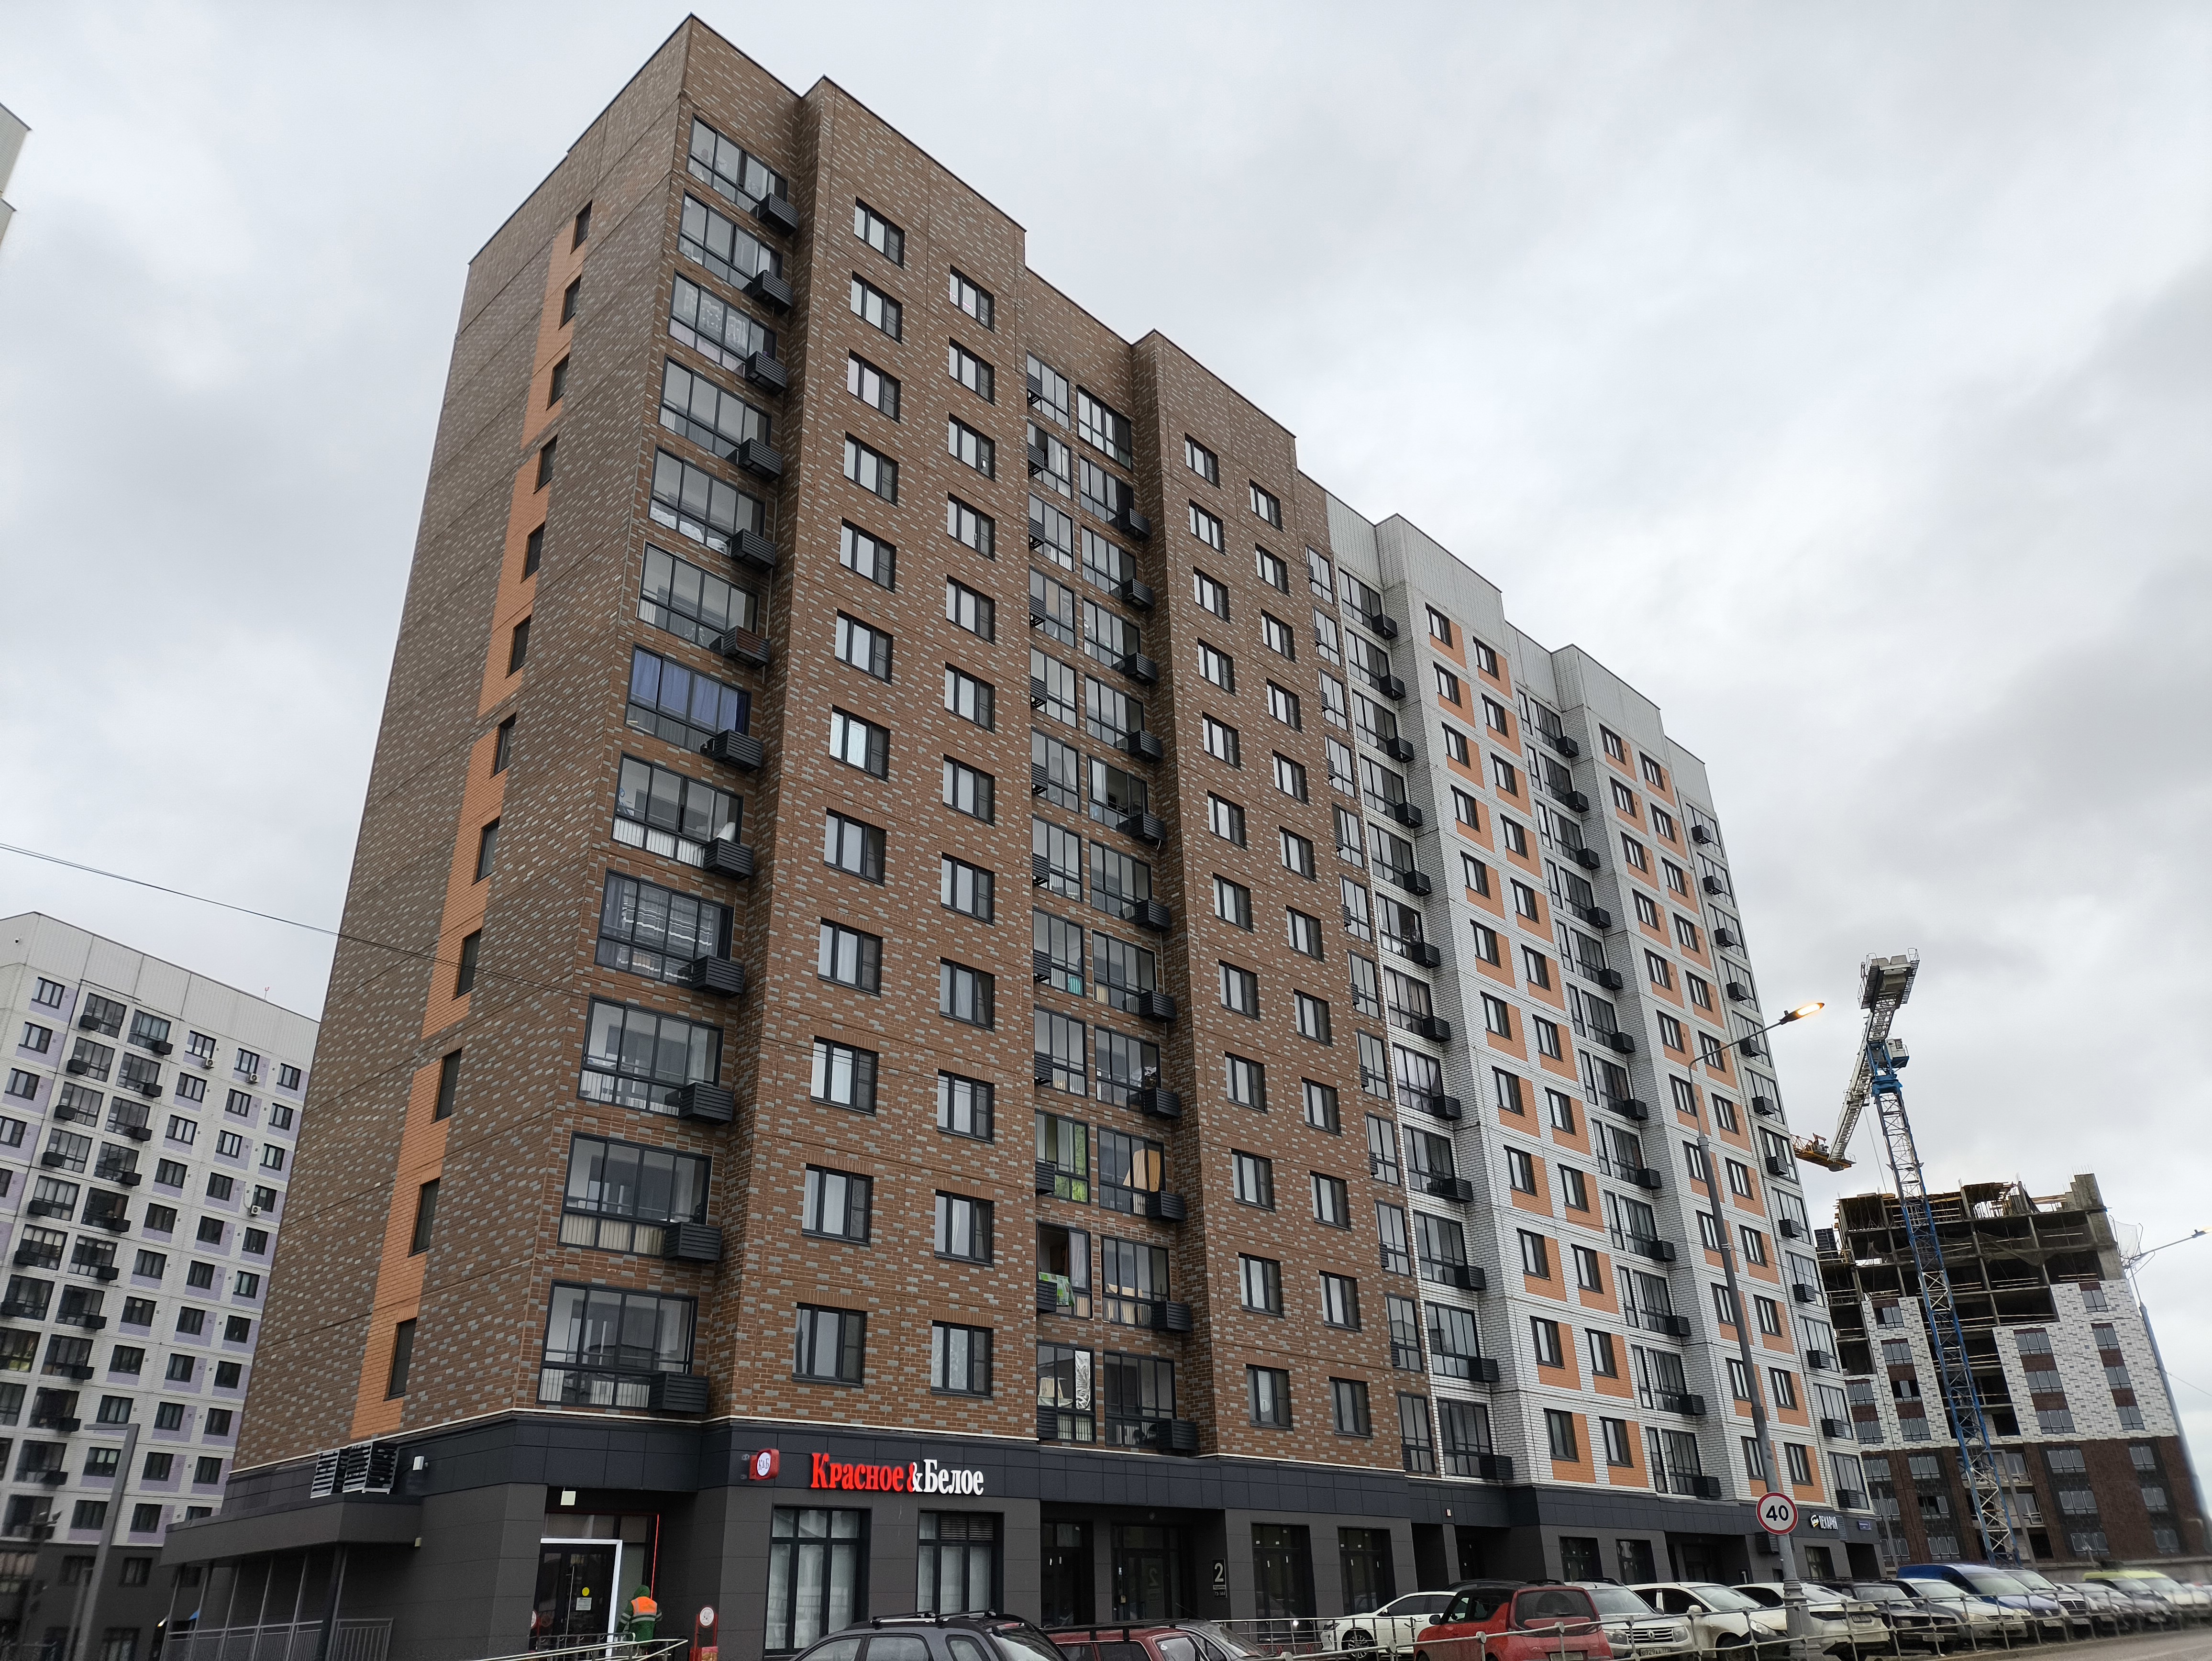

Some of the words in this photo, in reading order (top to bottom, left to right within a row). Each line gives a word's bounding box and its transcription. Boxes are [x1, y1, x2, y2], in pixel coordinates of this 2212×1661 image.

[758, 1458, 769, 1471] К&Б
[810, 1452, 904, 1492] Красное
[1766, 1505, 1789, 1521] 40
[1214, 1562, 1224, 1583] 2
